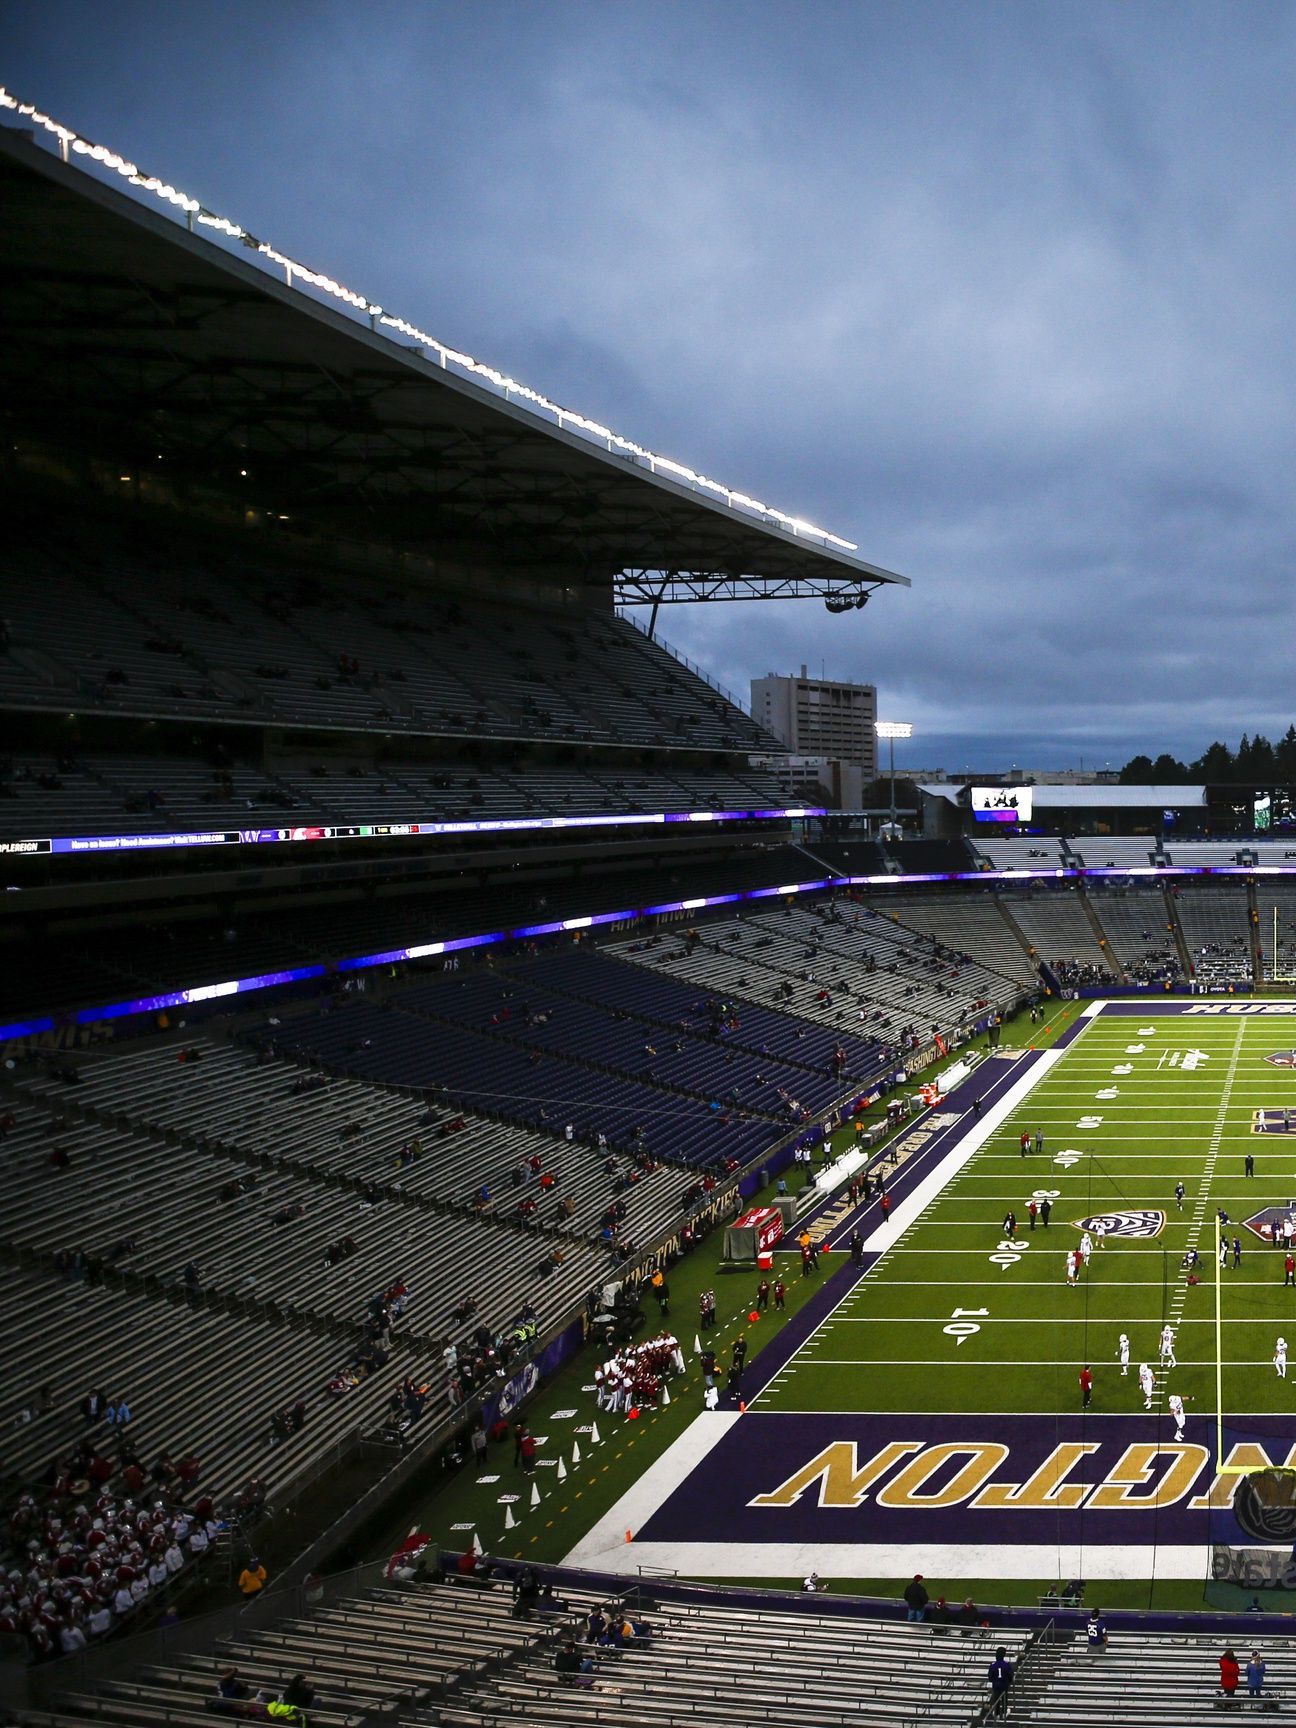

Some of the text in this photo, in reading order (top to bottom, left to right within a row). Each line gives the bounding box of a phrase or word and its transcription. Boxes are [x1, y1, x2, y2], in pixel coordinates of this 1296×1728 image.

[988, 1240, 1030, 1264] 20
[942, 1307, 990, 1335] 10
[1088, 1624, 1098, 1637] 25
[998, 1667, 1003, 1679] 1
